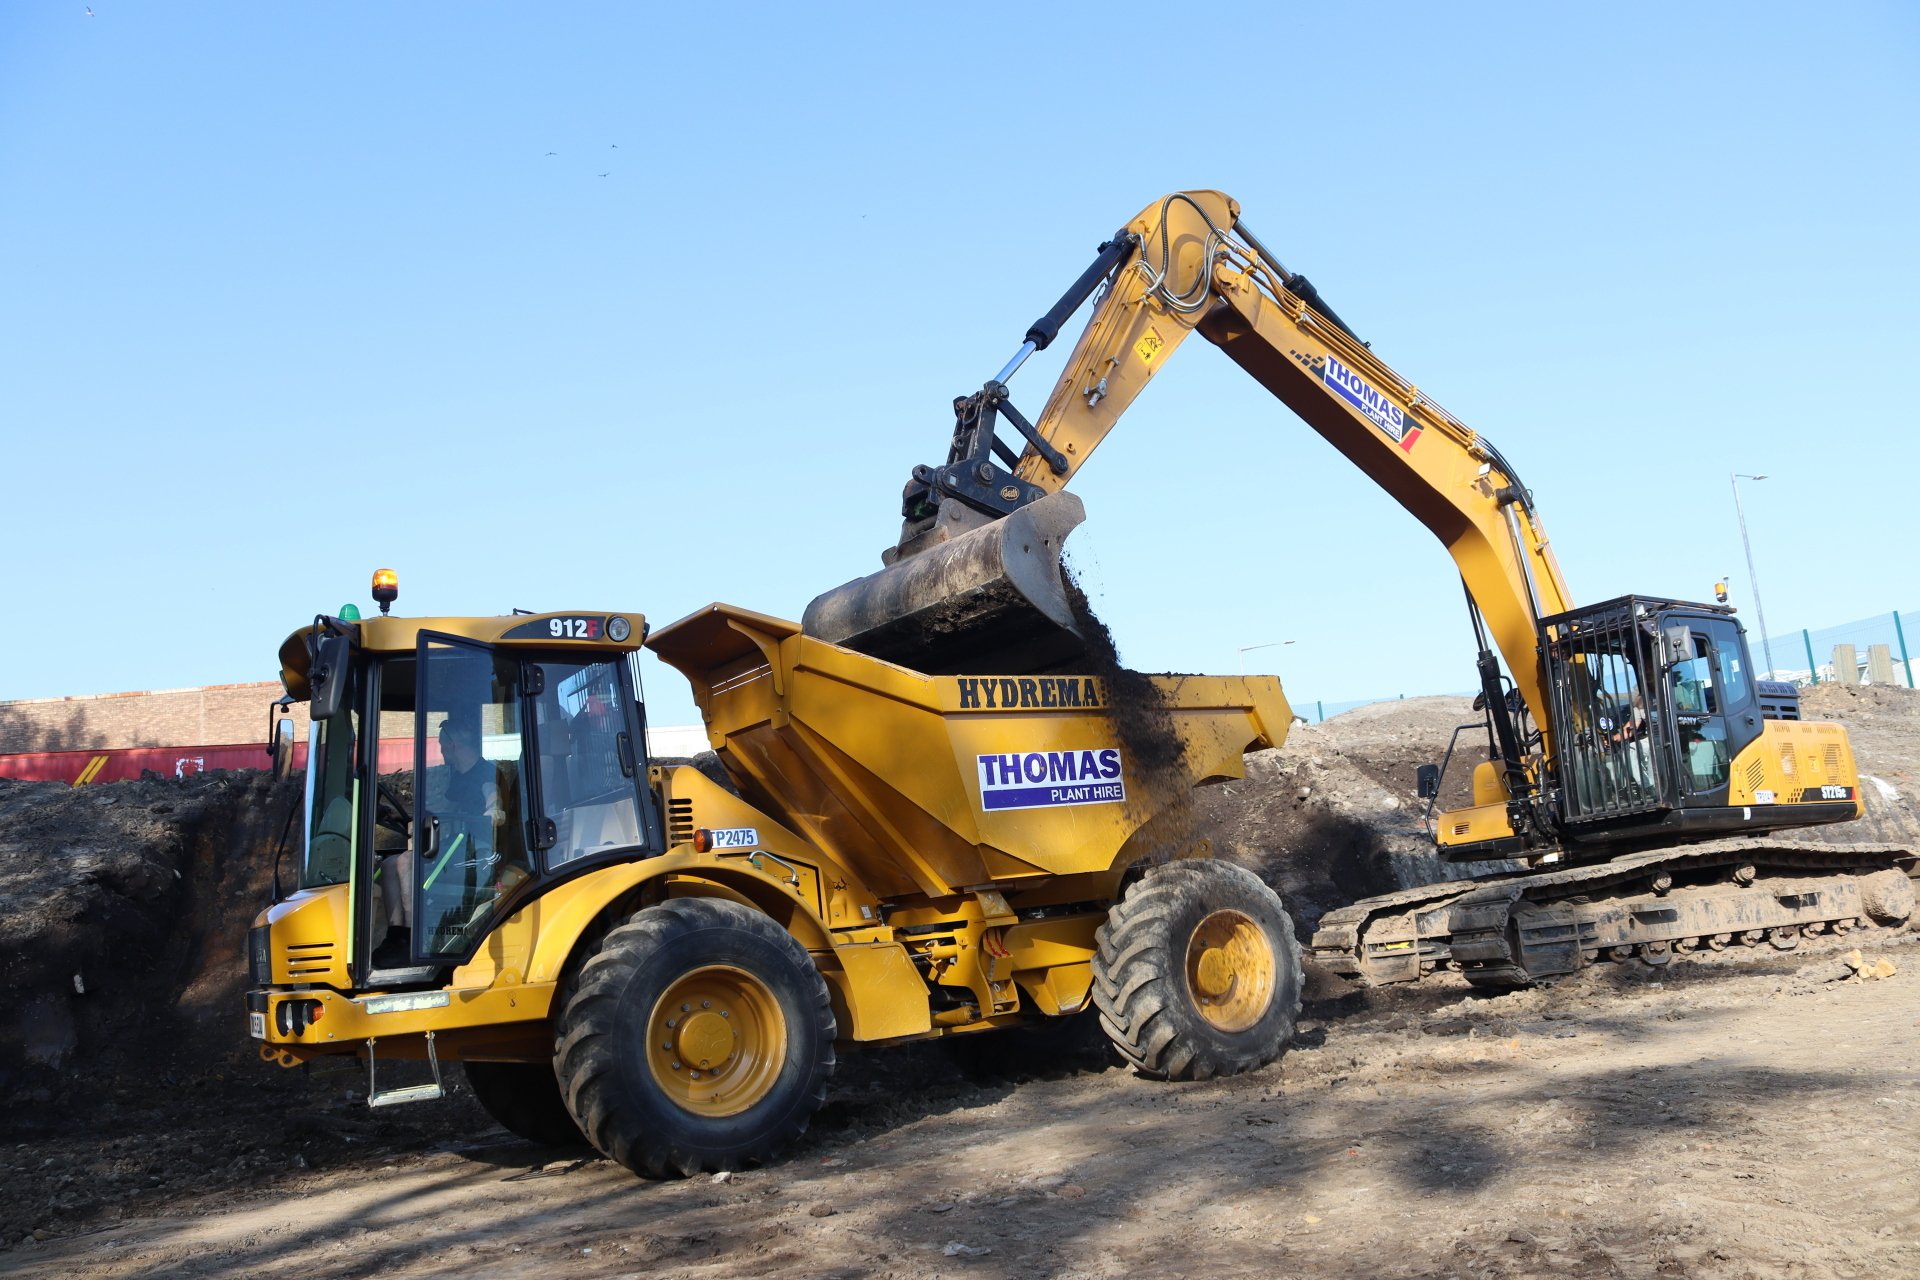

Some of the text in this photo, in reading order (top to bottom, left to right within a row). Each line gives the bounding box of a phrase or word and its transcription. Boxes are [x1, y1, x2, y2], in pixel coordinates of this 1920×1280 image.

[1327, 354, 1402, 426] THOMAS
[1361, 402, 1401, 438] PLANT HIRE
[549, 618, 599, 638] 912F
[957, 678, 1100, 708] HYDREMA
[978, 749, 1122, 786] THOMAS
[1051, 785, 1122, 802] PLANT HIRE
